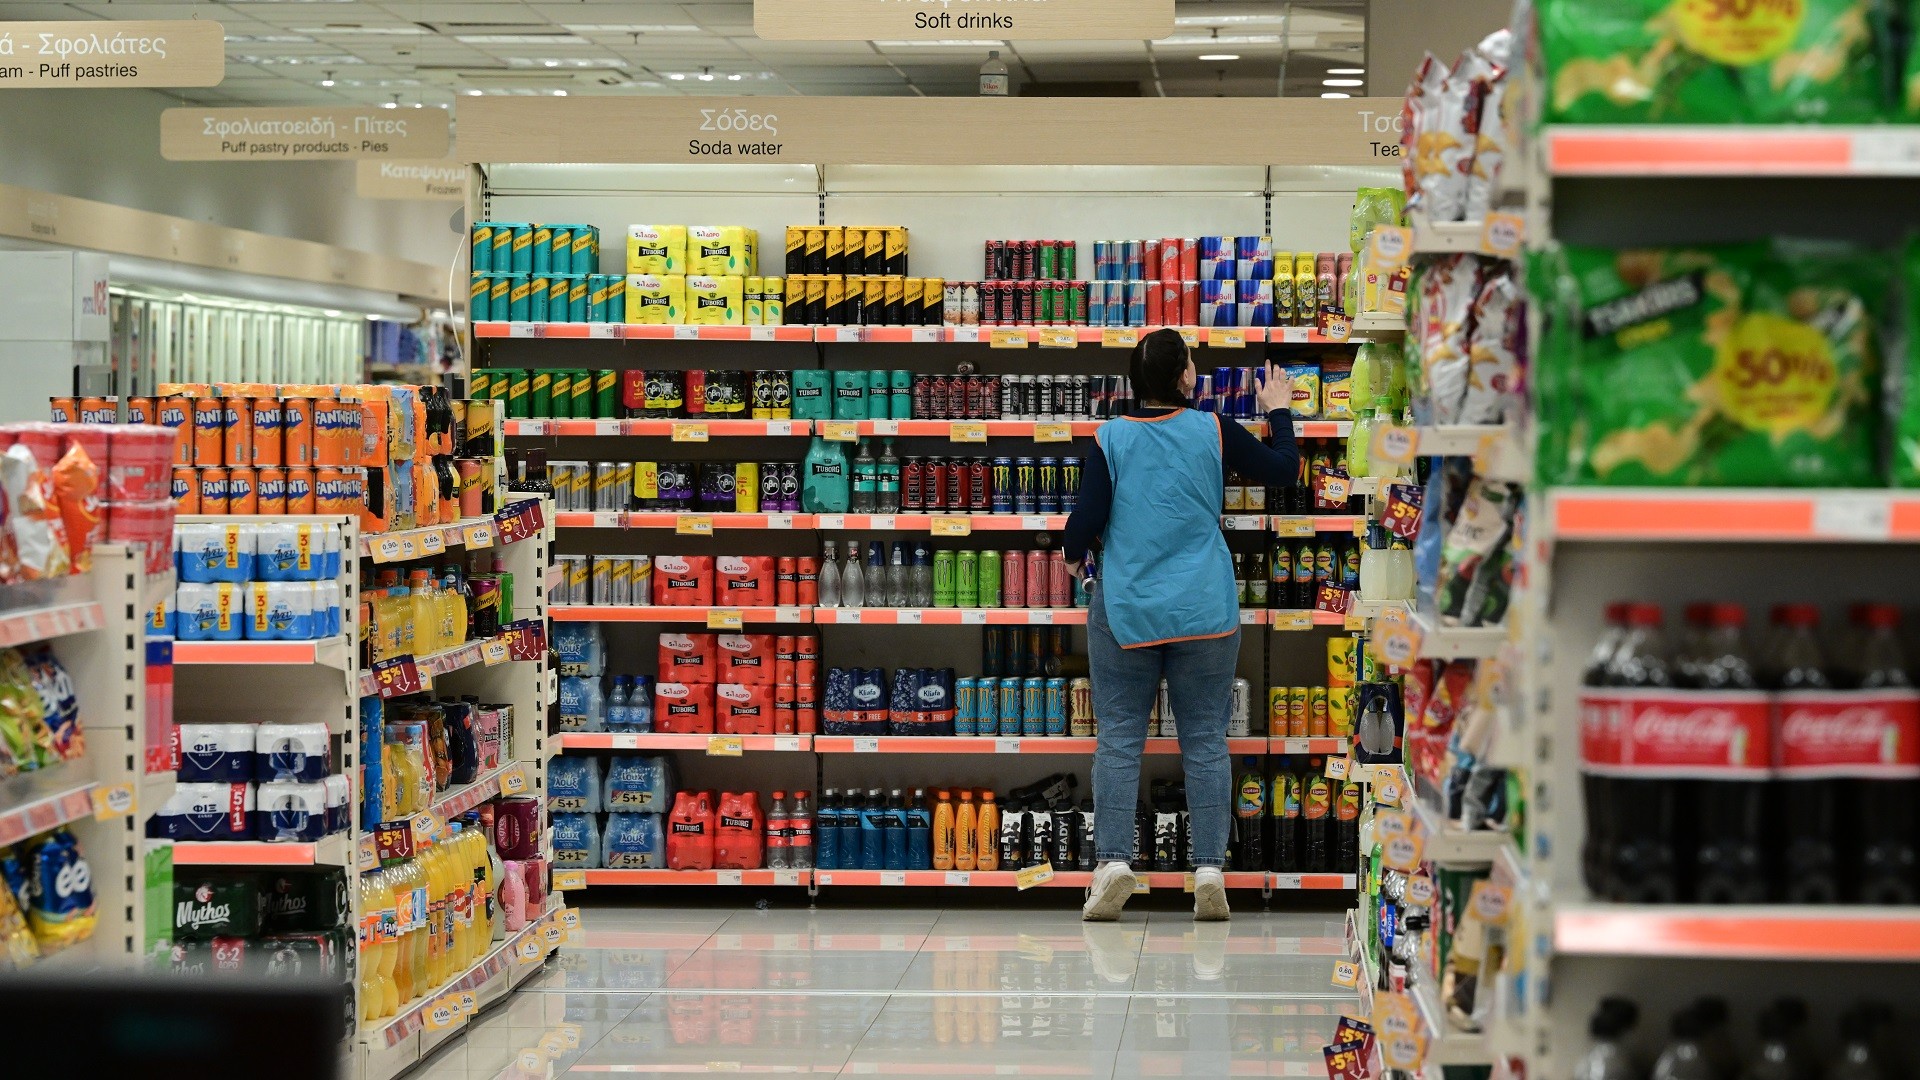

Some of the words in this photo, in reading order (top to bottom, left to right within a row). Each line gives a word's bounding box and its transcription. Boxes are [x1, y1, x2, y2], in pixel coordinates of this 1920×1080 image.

[914, 12, 950, 30] Soft
[956, 12, 1013, 30] drinks
[38, 33, 167, 57] Σφολιάτες
[39, 62, 71, 78] Puff
[75, 62, 138, 81] pastries
[202, 116, 336, 138] Σφολιατοειδή
[354, 115, 408, 137] Πίτες
[700, 109, 777, 136] Σόδες
[221, 140, 245, 154] Puff
[250, 140, 289, 157] pastry
[293, 140, 349, 157] products
[361, 139, 389, 154] Pies
[688, 140, 732, 155] Soda
[738, 141, 783, 155] water
[1370, 142, 1400, 158] Tea
[426, 183, 463, 195] Frozen
[642, 247, 664, 256] TUBORG
[705, 247, 728, 256] TUBORG
[644, 297, 667, 305] TUBORG
[839, 389, 860, 397] TUBORG
[815, 465, 841, 473] TUBORG
[1392, 501, 1417, 519] -5%
[671, 580, 695, 588] TUBORG
[677, 657, 700, 665] TUBORG
[735, 657, 758, 666] TUBORG
[378, 668, 401, 684] -5%
[672, 706, 695, 714] TUBORG
[733, 707, 756, 715] TUBORG
[622, 794, 644, 803] 5+1
[558, 799, 581, 808] 5+1
[193, 804, 217, 813] ΦΙΞ
[233, 792, 243, 826] 5+1
[676, 824, 701, 832] TUBORG
[725, 819, 749, 828] TUBORG
[379, 830, 402, 846] -5%
[1059, 821, 1069, 860] READY
[558, 852, 581, 860] 5+1
[623, 855, 647, 864] 5+1
[176, 901, 231, 929] Mythos
[1330, 1052, 1355, 1070] -5%
